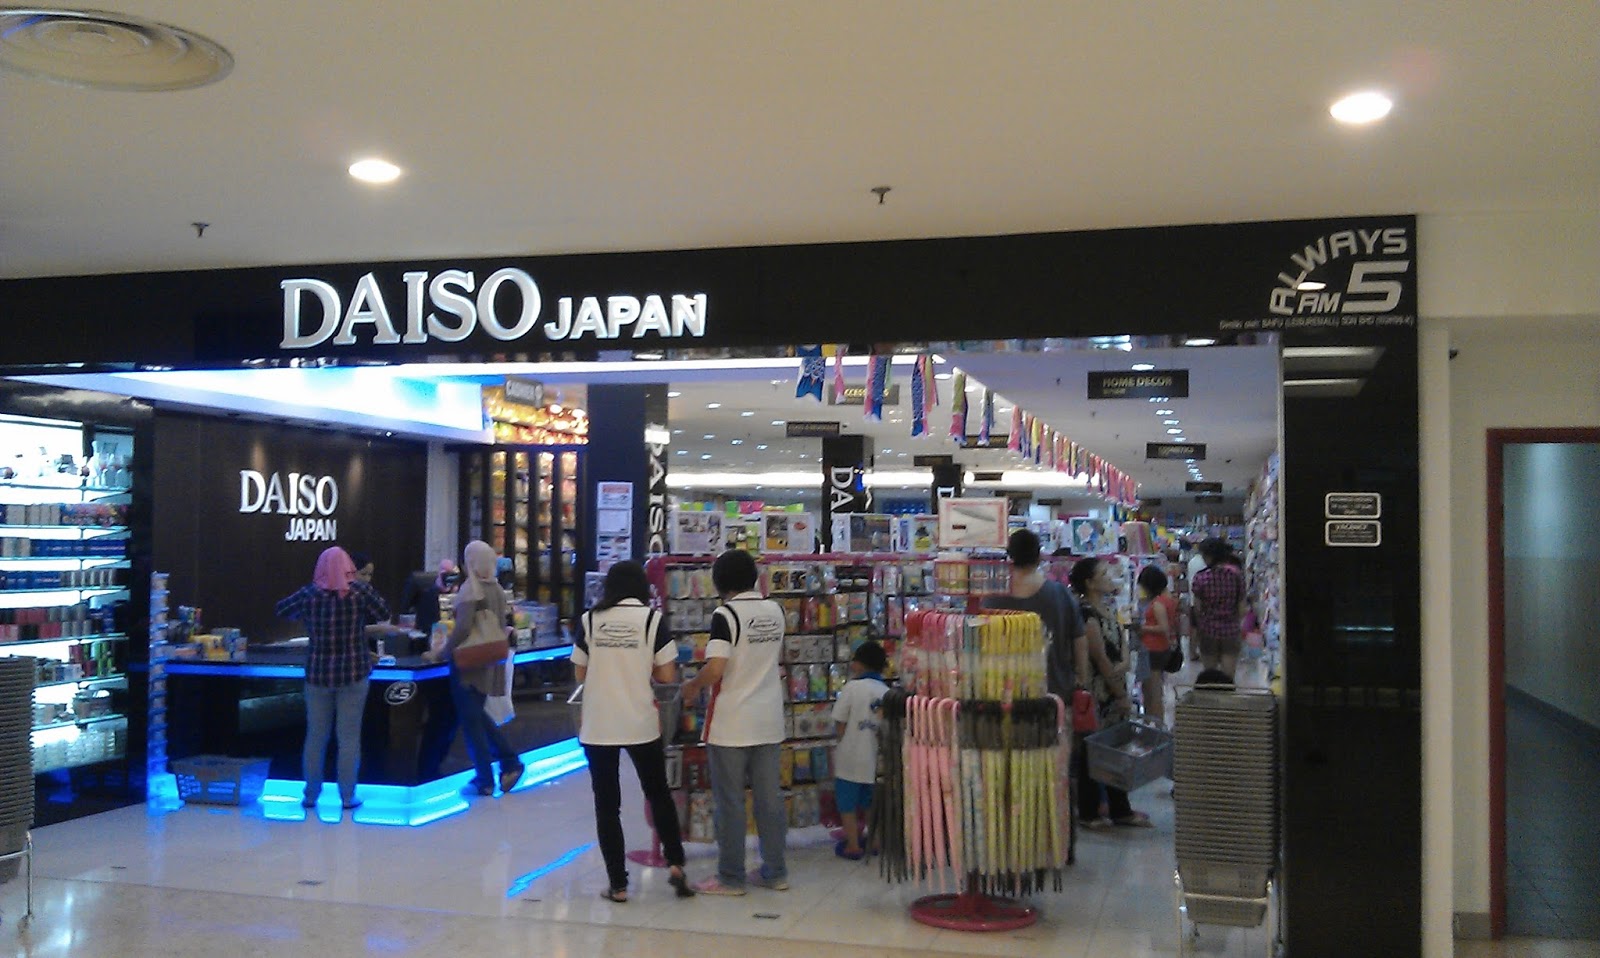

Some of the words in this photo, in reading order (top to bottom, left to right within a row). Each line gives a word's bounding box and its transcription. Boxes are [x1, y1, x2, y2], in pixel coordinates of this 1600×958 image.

[1269, 227, 1407, 316] ALWAYS
[1341, 259, 1411, 314] 5
[279, 267, 541, 349] DAISO
[543, 293, 707, 340] JAPAN
[1103, 377, 1135, 387] HOME
[1136, 376, 1173, 387] DECOR
[239, 469, 339, 515] DAISO
[285, 518, 337, 541] JAPAN
